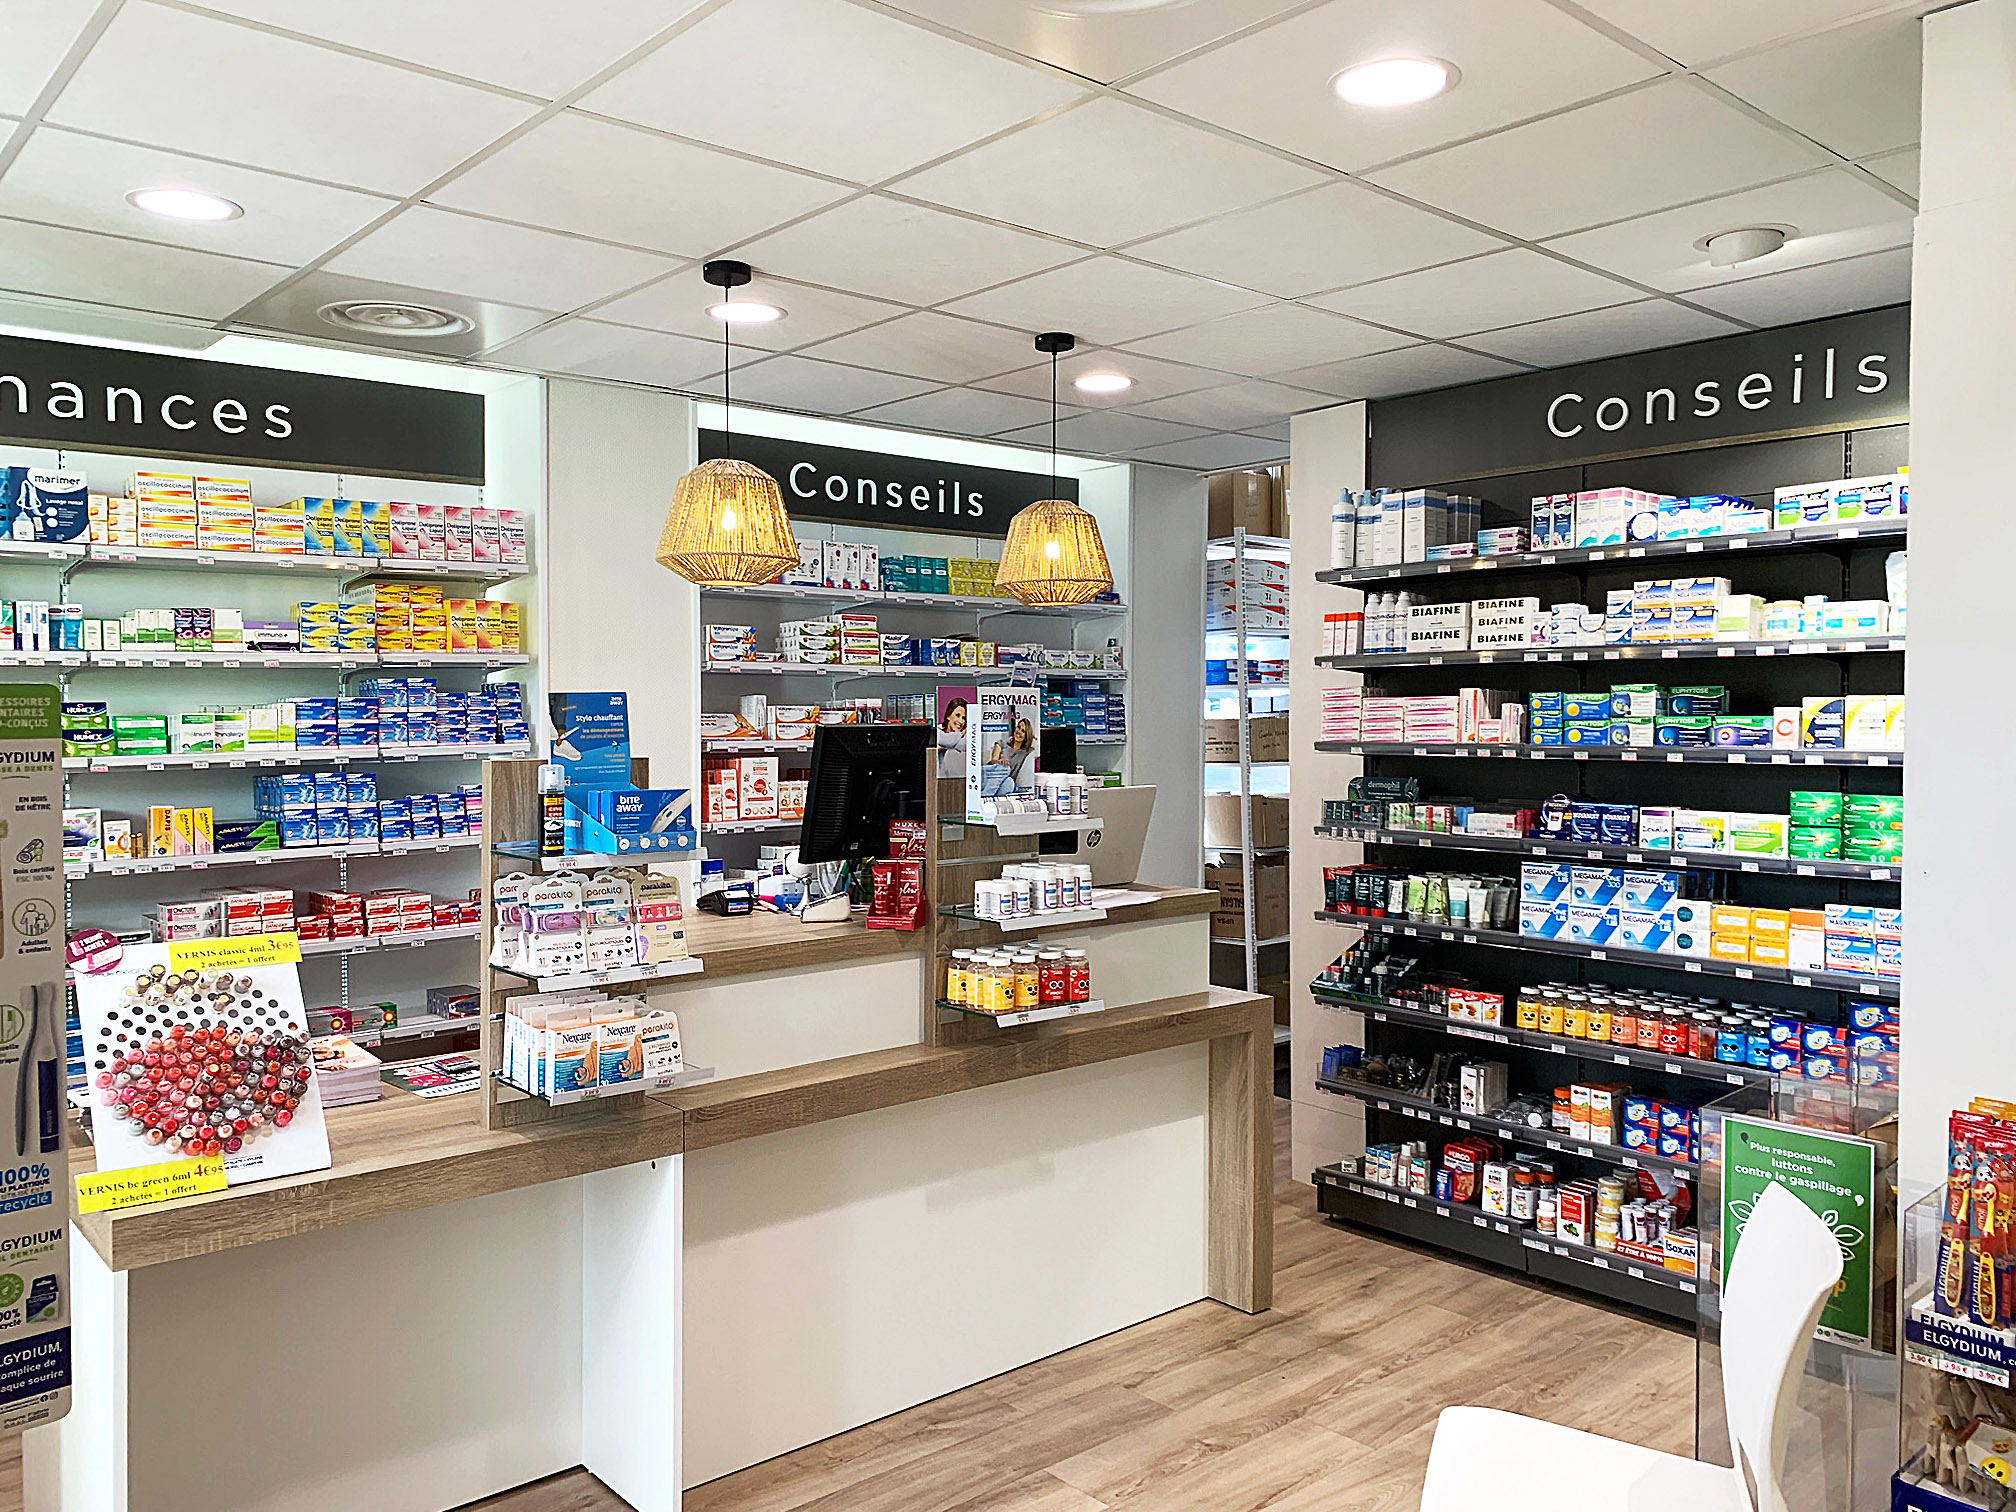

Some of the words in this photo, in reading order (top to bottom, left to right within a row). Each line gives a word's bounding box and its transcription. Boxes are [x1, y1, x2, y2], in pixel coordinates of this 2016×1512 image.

[1547, 347, 1888, 438] Conseils
[34, 474, 80, 485] marimer
[790, 463, 984, 517] Conseils
[1478, 600, 1524, 609] BIAFINE
[1412, 605, 1461, 617] BIAFINE
[1478, 617, 1524, 626] BIAFINE
[1412, 630, 1460, 640] BIAFINE
[1477, 634, 1524, 643] BIAFINE
[981, 695, 1037, 706] ERGYMAG
[67, 706, 95, 714] HUMEX
[983, 711, 1020, 720] ERGYMAG
[74, 733, 102, 741] HUMEX
[1368, 780, 1400, 790] dermophil
[620, 795, 640, 804] bite
[616, 804, 644, 812] away
[1524, 868, 1555, 876] MEGAMAG
[1574, 872, 1606, 881] MEGAMAG
[1626, 876, 1659, 885] MEGAMAG
[586, 886, 622, 897] parakito
[640, 883, 671, 891] parakito
[534, 891, 573, 901] parakito
[1522, 905, 1552, 914] MEGAMAG
[1572, 910, 1603, 919] MEGAMAG
[1623, 915, 1656, 924] MEGAMAG
[176, 948, 216, 960] VERNIS
[218, 947, 246, 956] classic
[249, 945, 265, 954] 4ml
[607, 1025, 636, 1036] Nexcare
[562, 1032, 592, 1044] Nexcare
[1750, 1141, 1770, 1154] Plus
[1772, 1146, 1835, 1167] responsable,
[1772, 1158, 1813, 1175] luttons
[79, 1181, 124, 1196] VERNIS
[127, 1179, 139, 1190] be
[142, 1176, 169, 1188] green
[172, 1171, 191, 1182] 6ml
[1735, 1165, 1772, 1180] contre
[1775, 1172, 1787, 1182] le
[1789, 1174, 1852, 1197] gaspillage
[111, 1197, 117, 1205] 2
[119, 1191, 153, 1204] achetés
[172, 1183, 197, 1194] offert
[44, 1359, 56, 1368] de
[28, 1369, 64, 1385] sourire
